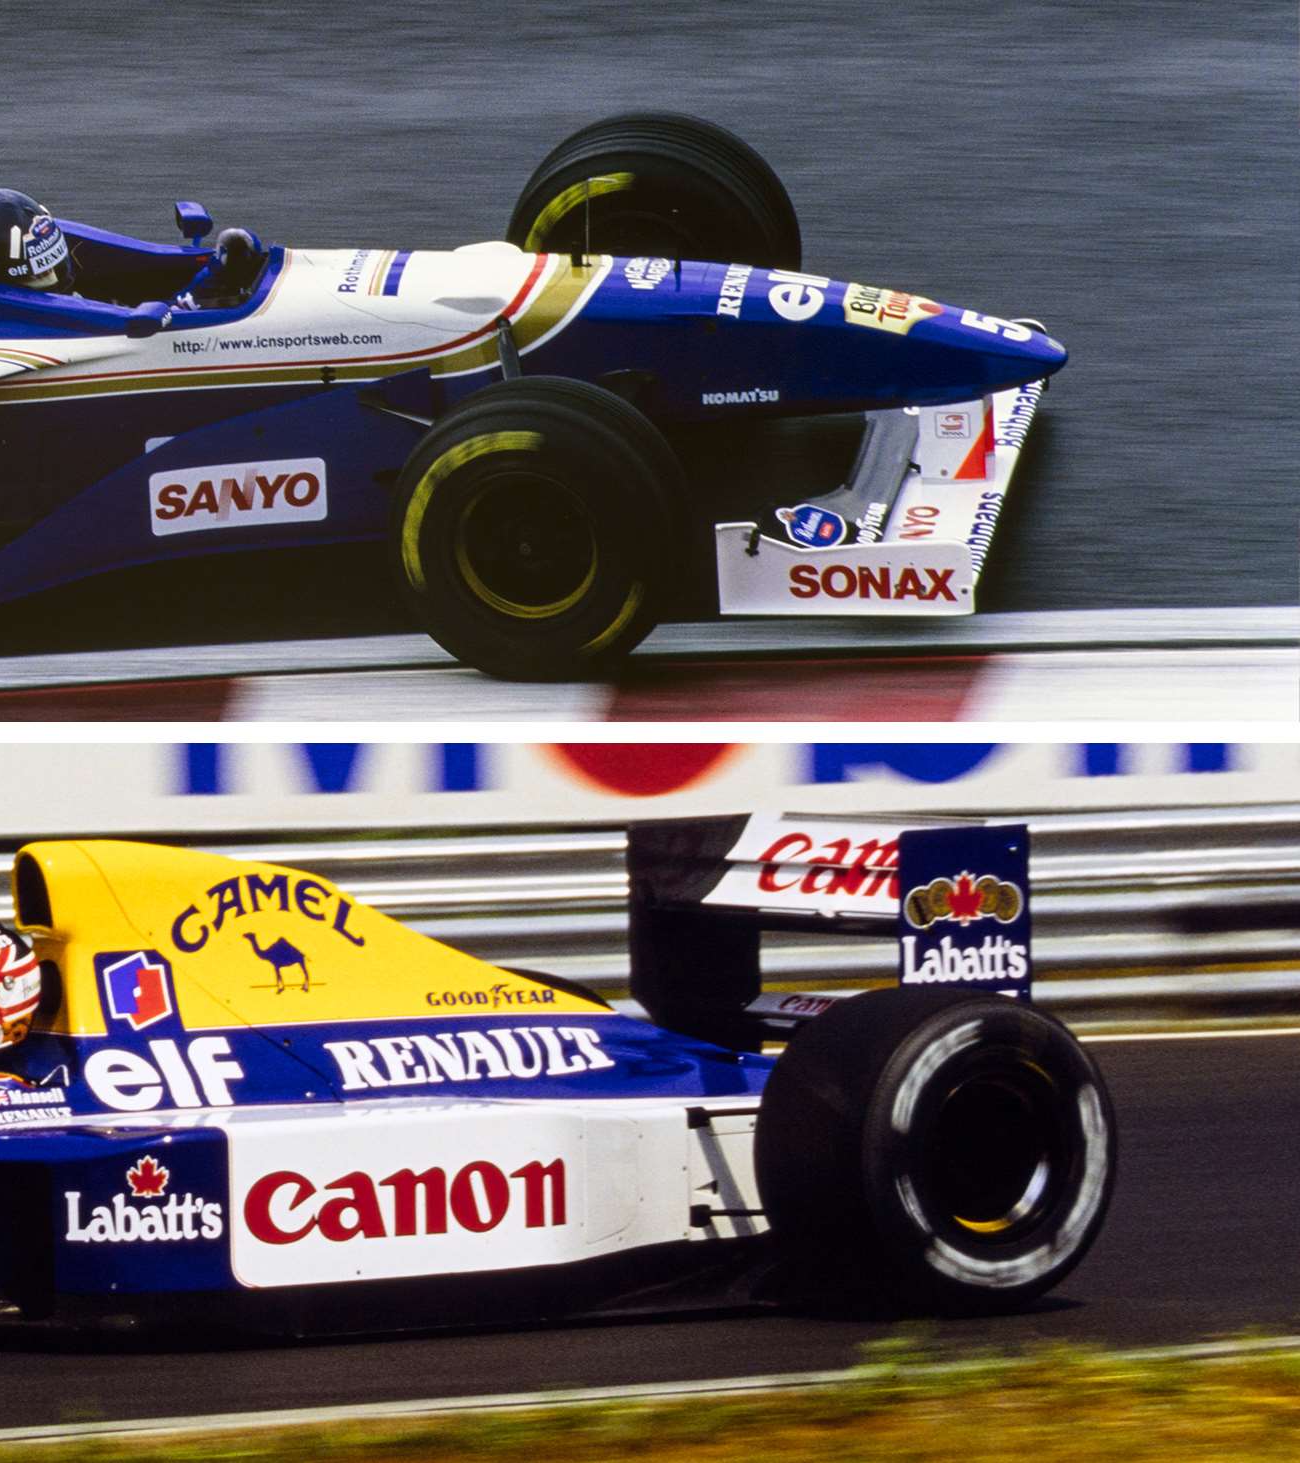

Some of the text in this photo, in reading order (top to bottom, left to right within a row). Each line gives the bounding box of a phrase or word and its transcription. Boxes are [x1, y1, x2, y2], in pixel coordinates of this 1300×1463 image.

[8, 264, 29, 277] elf
[172, 332, 382, 354] http://www.icnsportsweb.com
[960, 310, 1032, 342] 5
[702, 387, 780, 405] KOMATSU
[155, 467, 320, 521] SANYO
[789, 564, 958, 602] SONAX
[171, 873, 365, 953] CAMEL
[901, 934, 1028, 985] Labatt's
[425, 984, 558, 1009] GOODYEAR
[84, 1035, 245, 1112] elf
[323, 1026, 616, 1092] RENAULT
[7, 1088, 66, 1105] Mansell
[64, 1191, 224, 1243] Labatt's
